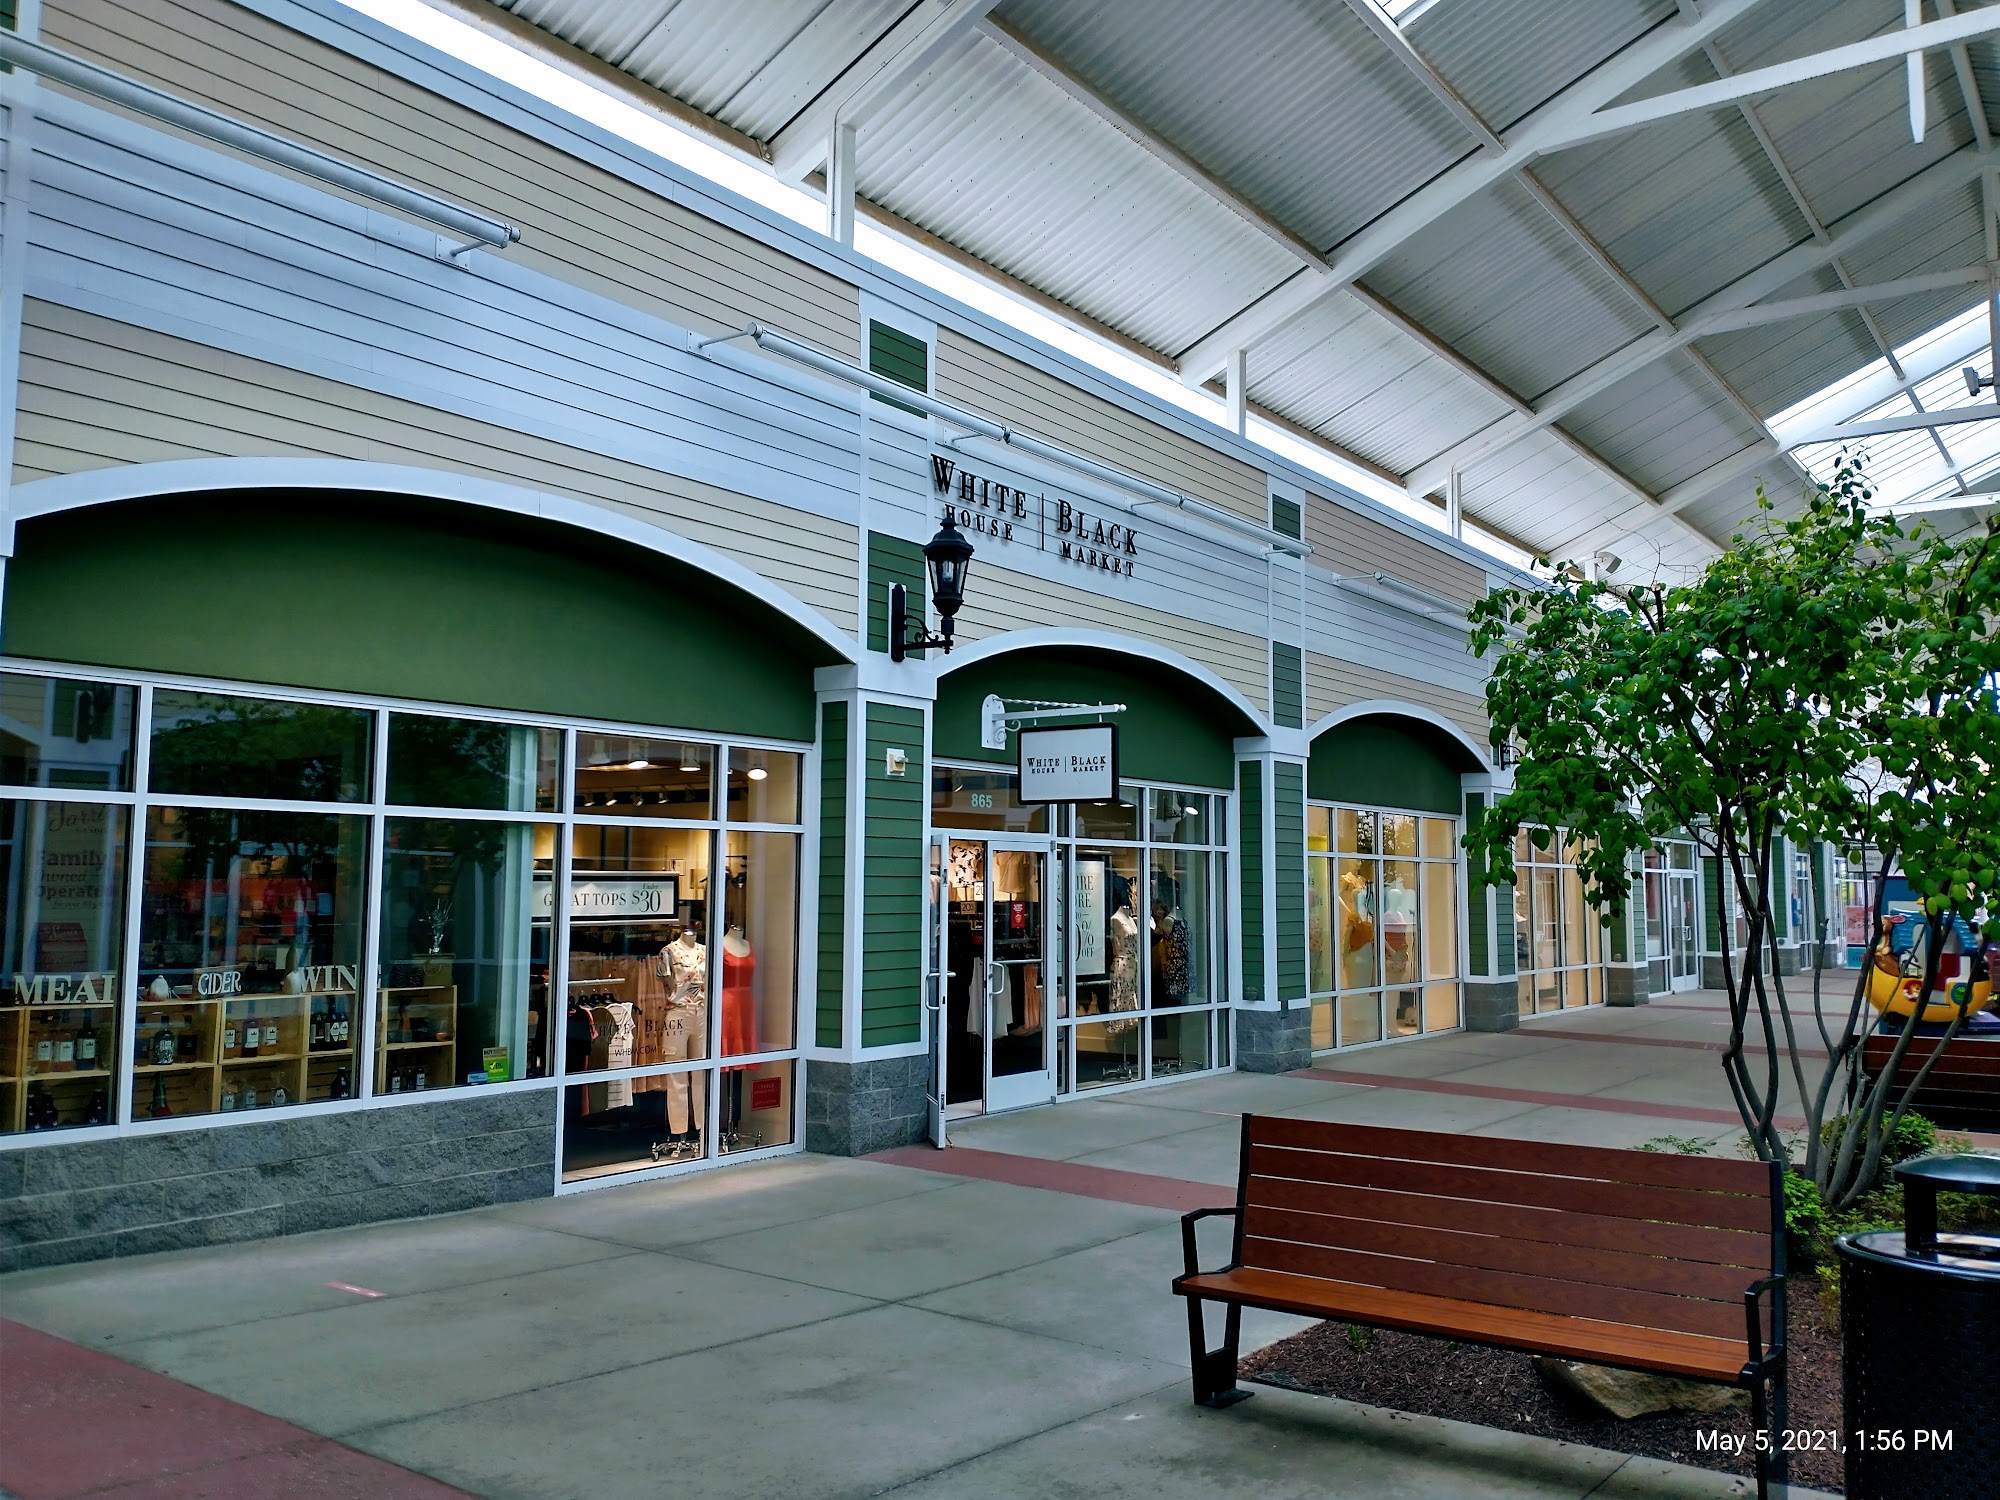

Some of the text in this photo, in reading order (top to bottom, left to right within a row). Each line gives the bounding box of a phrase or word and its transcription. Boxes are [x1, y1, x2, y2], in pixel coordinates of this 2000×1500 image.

[930, 453, 1027, 520] WHITE
[944, 503, 1013, 541] HOUSE
[1057, 498, 1138, 556] BLACK
[1061, 541, 1134, 577] MARKET
[1027, 757, 1060, 767] WHITE
[1071, 755, 1106, 766] BLACK
[1073, 765, 1105, 773] MARKET
[971, 793, 993, 809] 865
[543, 893, 589, 907] GAT
[593, 893, 627, 906] TOPS
[198, 971, 242, 995] CIDER
[298, 964, 382, 992] WIN
[645, 1018, 684, 1034] BLACK
